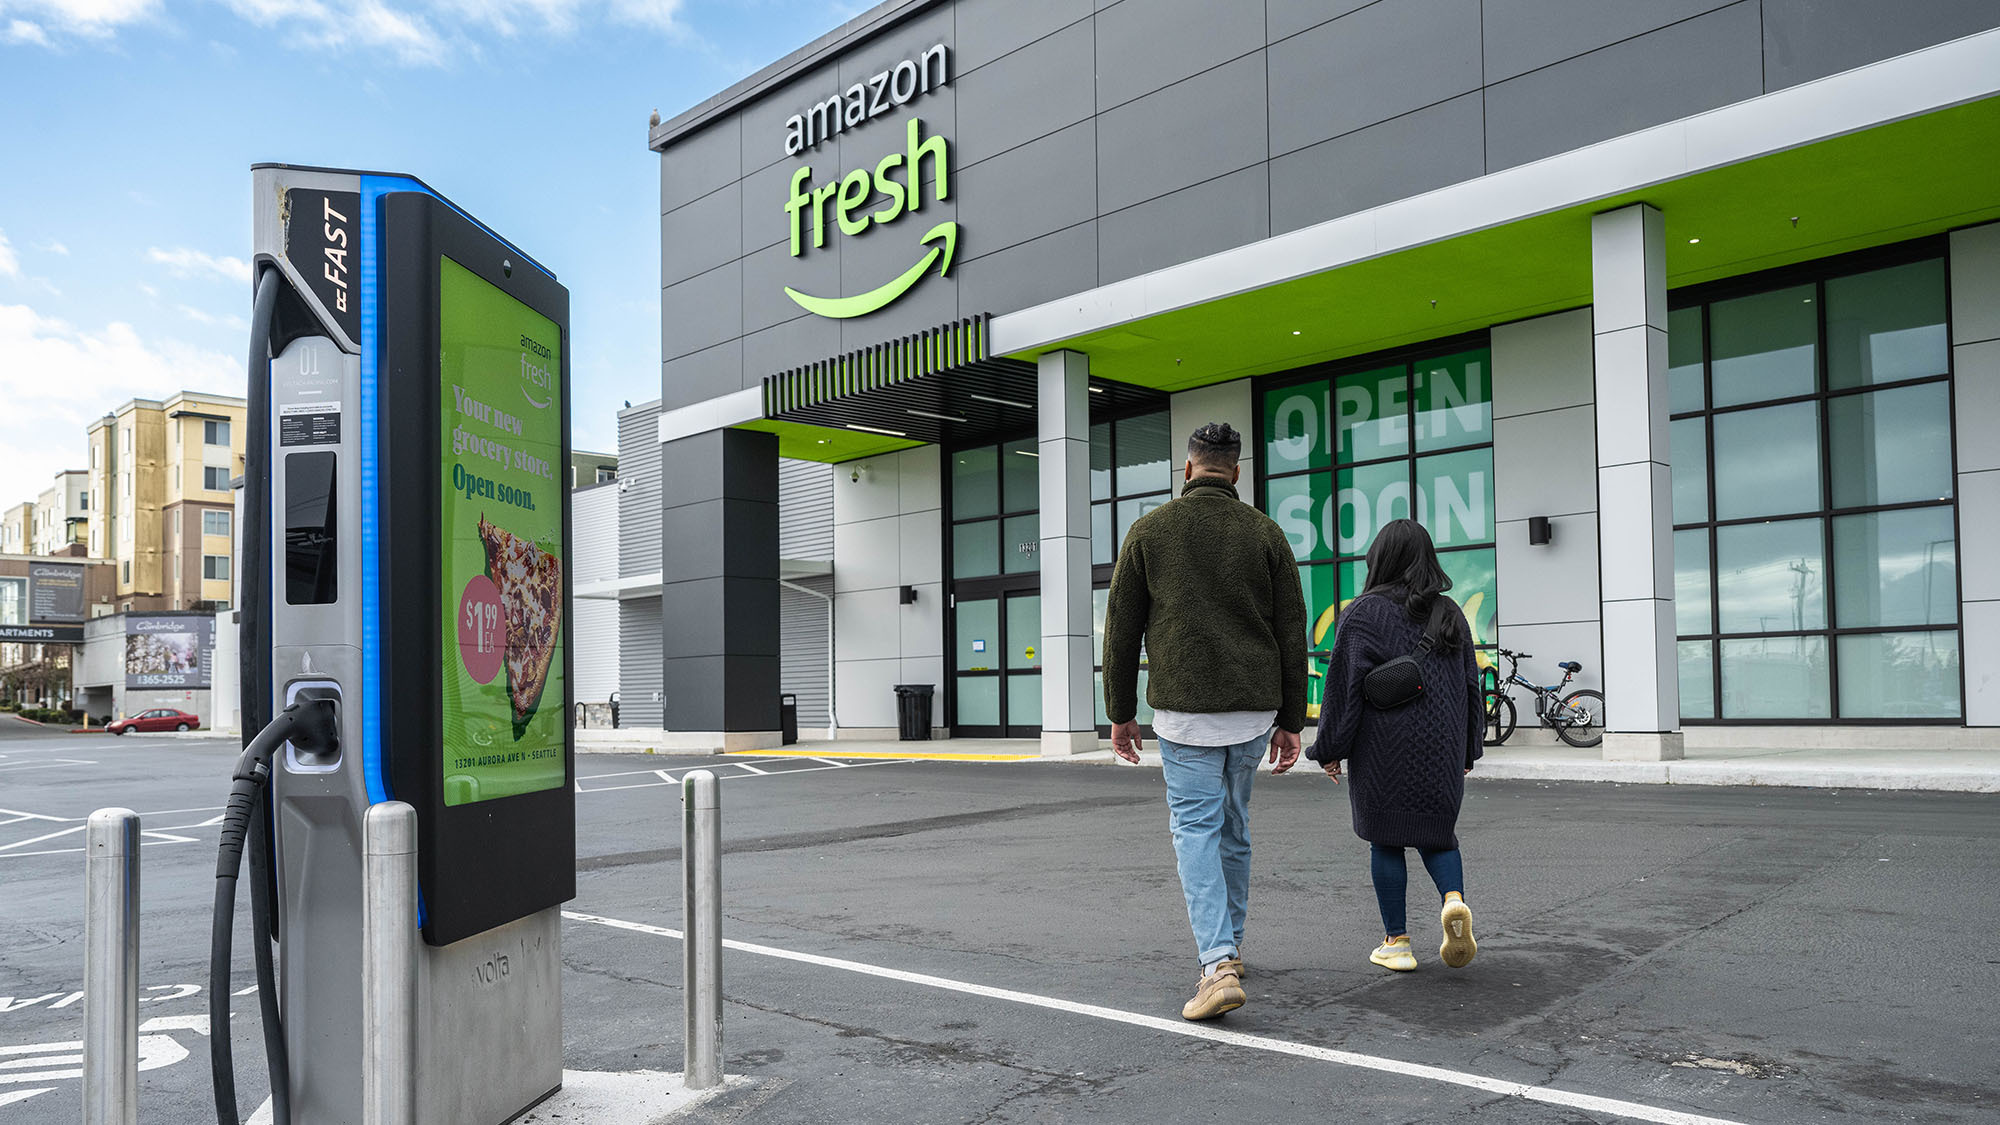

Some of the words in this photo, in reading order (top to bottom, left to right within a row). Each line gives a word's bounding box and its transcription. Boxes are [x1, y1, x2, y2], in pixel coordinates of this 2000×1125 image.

[785, 43, 947, 156] amazon
[784, 117, 948, 257] fresh
[324, 197, 348, 289] FAST
[520, 334, 552, 361] amazon
[520, 352, 551, 391] fresh
[452, 384, 491, 425] Your
[494, 409, 523, 436] new
[1274, 361, 1483, 462] OPEN
[452, 424, 512, 471] grocery
[514, 449, 553, 480] store.
[453, 463, 495, 500] Open
[498, 481, 536, 511] soon.
[1276, 471, 1486, 560] SOON
[135, 620, 185, 632] Cambridge
[455, 757, 476, 769] 13201
[478, 754, 506, 767] AURORA
[507, 752, 520, 763] AVE
[521, 751, 526, 761] N
[532, 748, 557, 760] SEATTLE
[476, 951, 510, 983] volta
